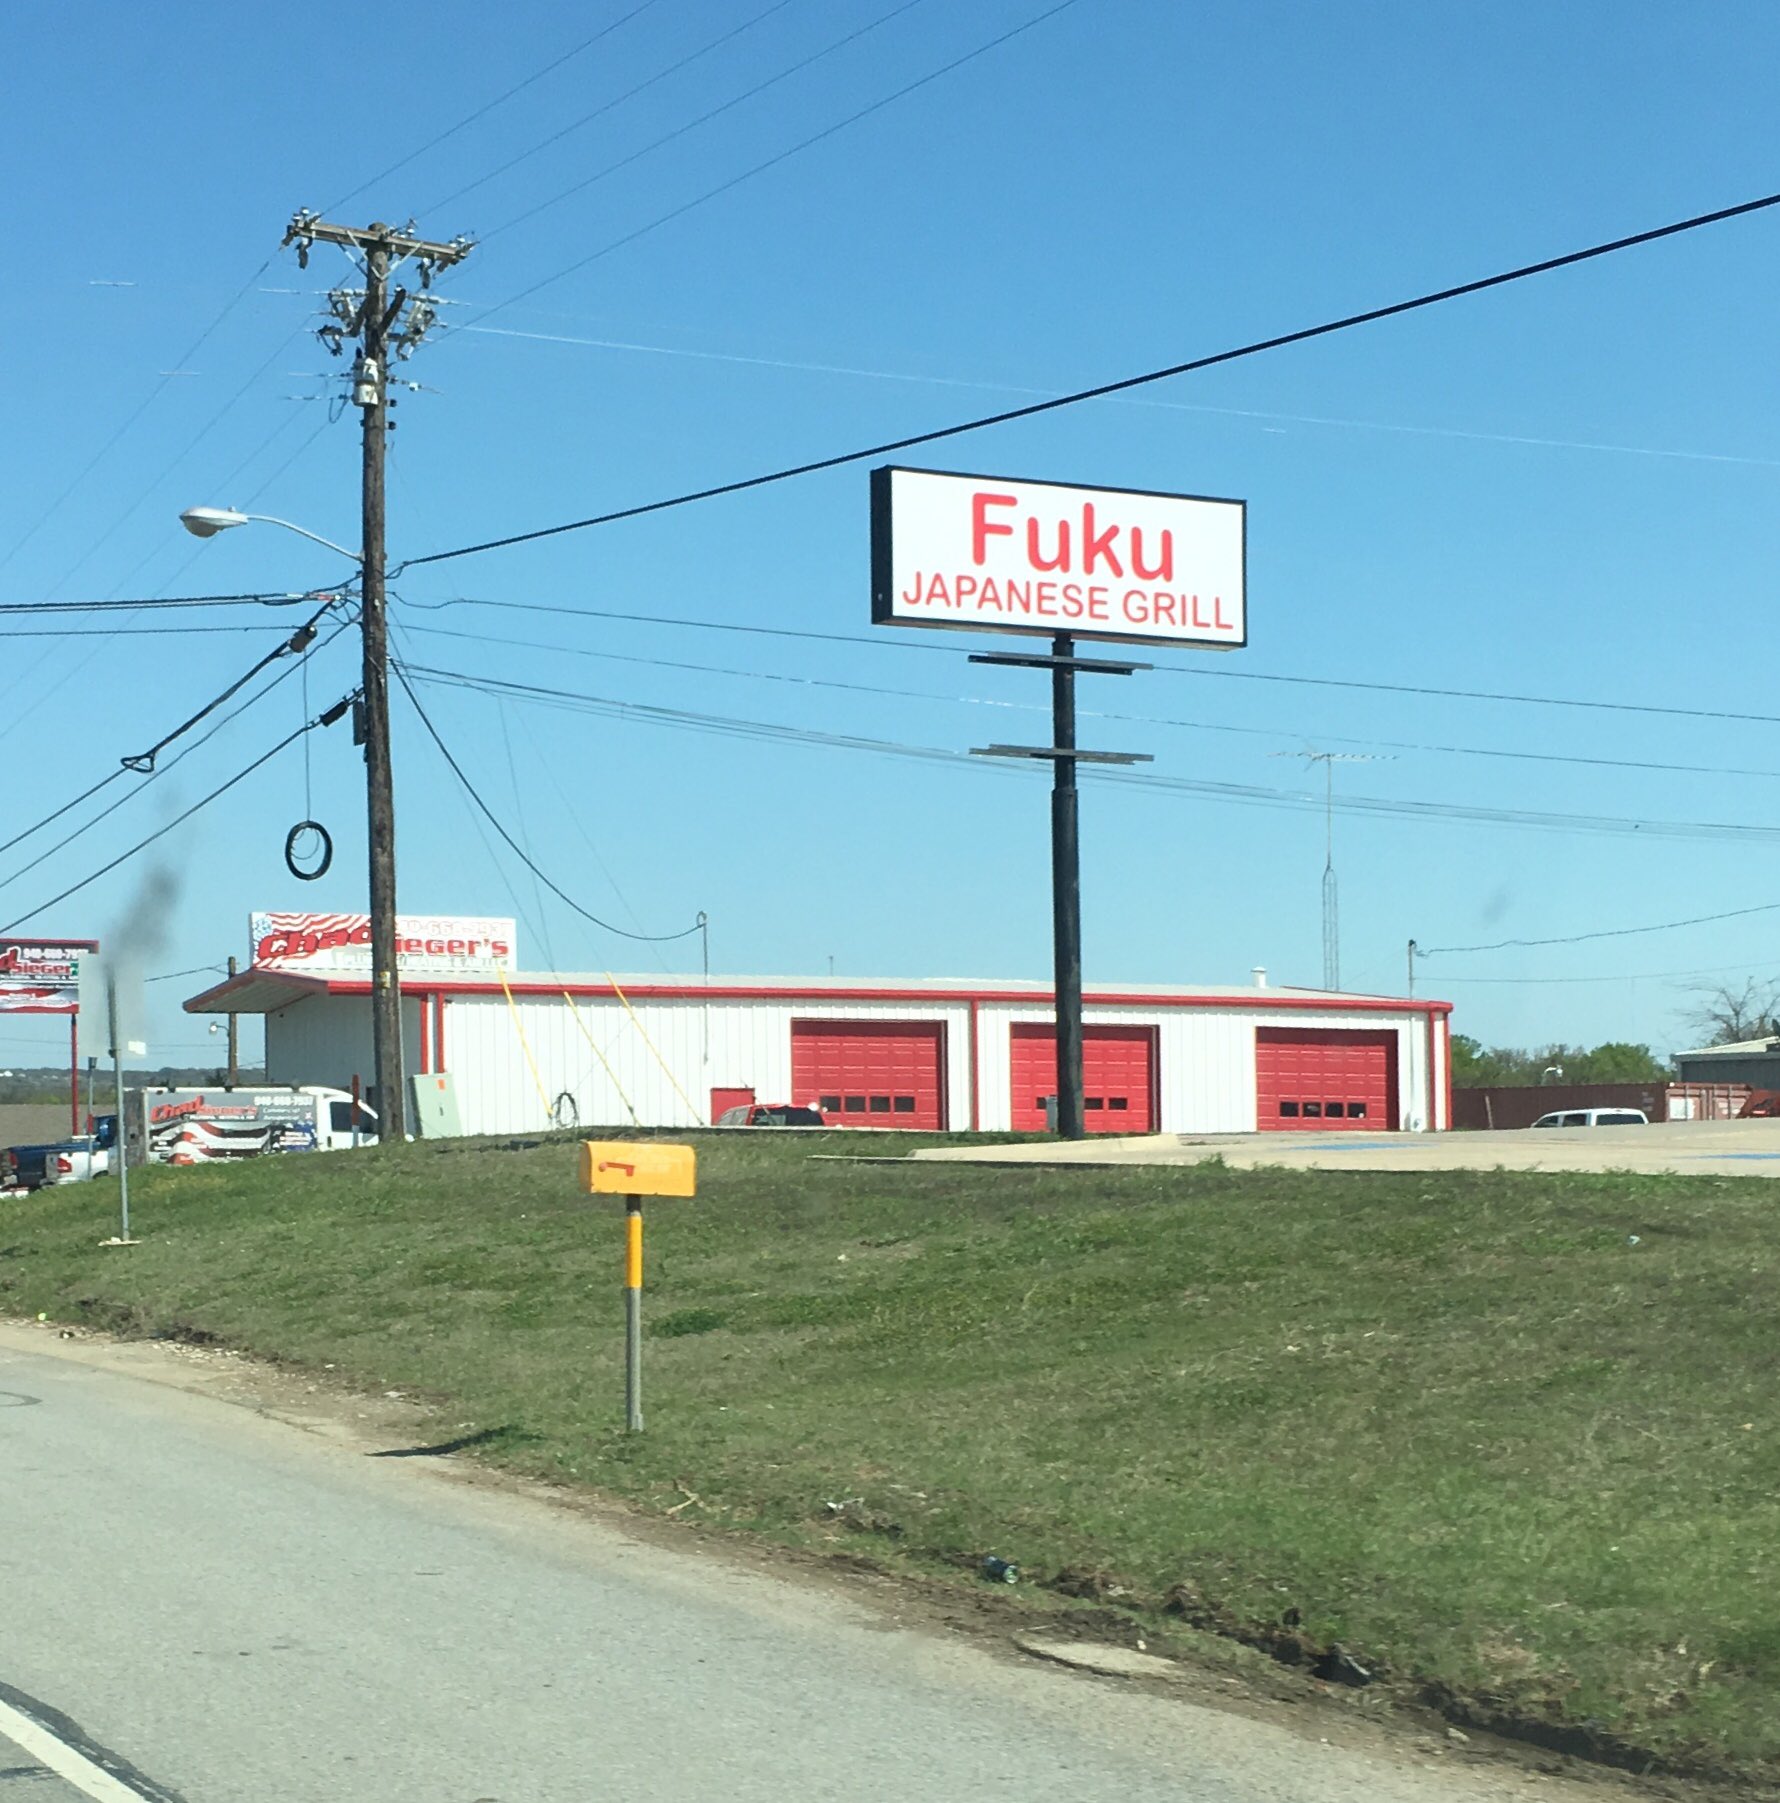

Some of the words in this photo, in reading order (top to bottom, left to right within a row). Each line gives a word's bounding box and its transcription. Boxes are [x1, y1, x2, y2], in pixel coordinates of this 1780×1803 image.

[972, 492, 1173, 582] Fuku
[902, 571, 1109, 620] JAPANESE
[1122, 590, 1234, 629] GRILL
[395, 934, 509, 958] ieger's
